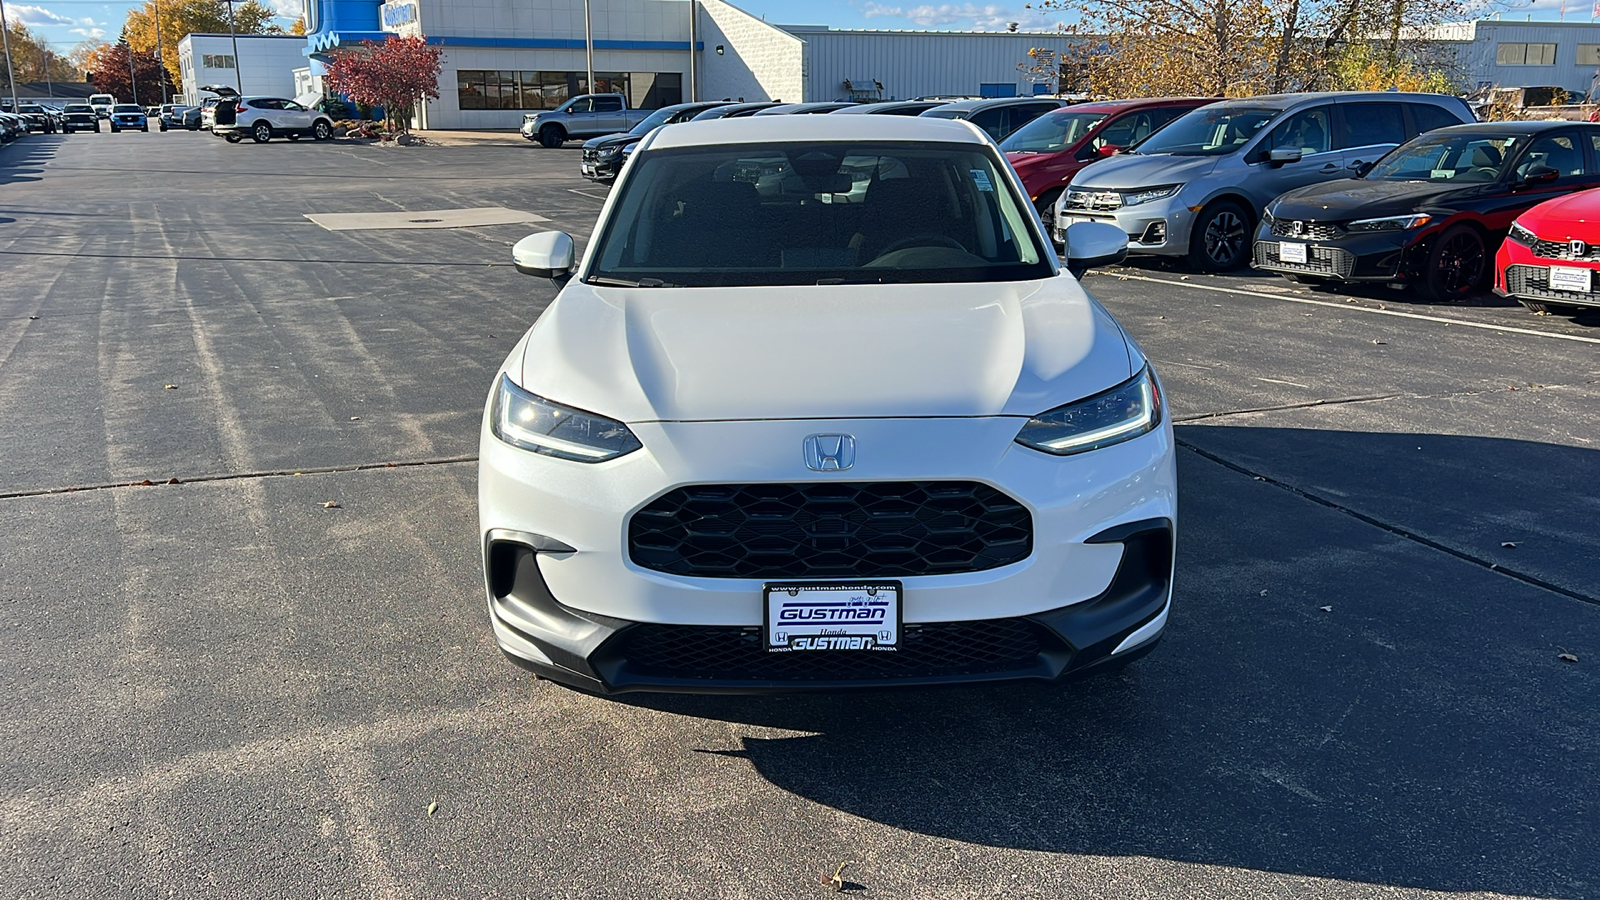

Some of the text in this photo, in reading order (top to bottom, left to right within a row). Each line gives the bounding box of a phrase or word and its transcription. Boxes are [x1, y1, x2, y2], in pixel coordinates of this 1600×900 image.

[780, 608, 886, 620] GUSTman
[820, 628, 848, 636] Honda
[792, 637, 873, 650] GUSTman
